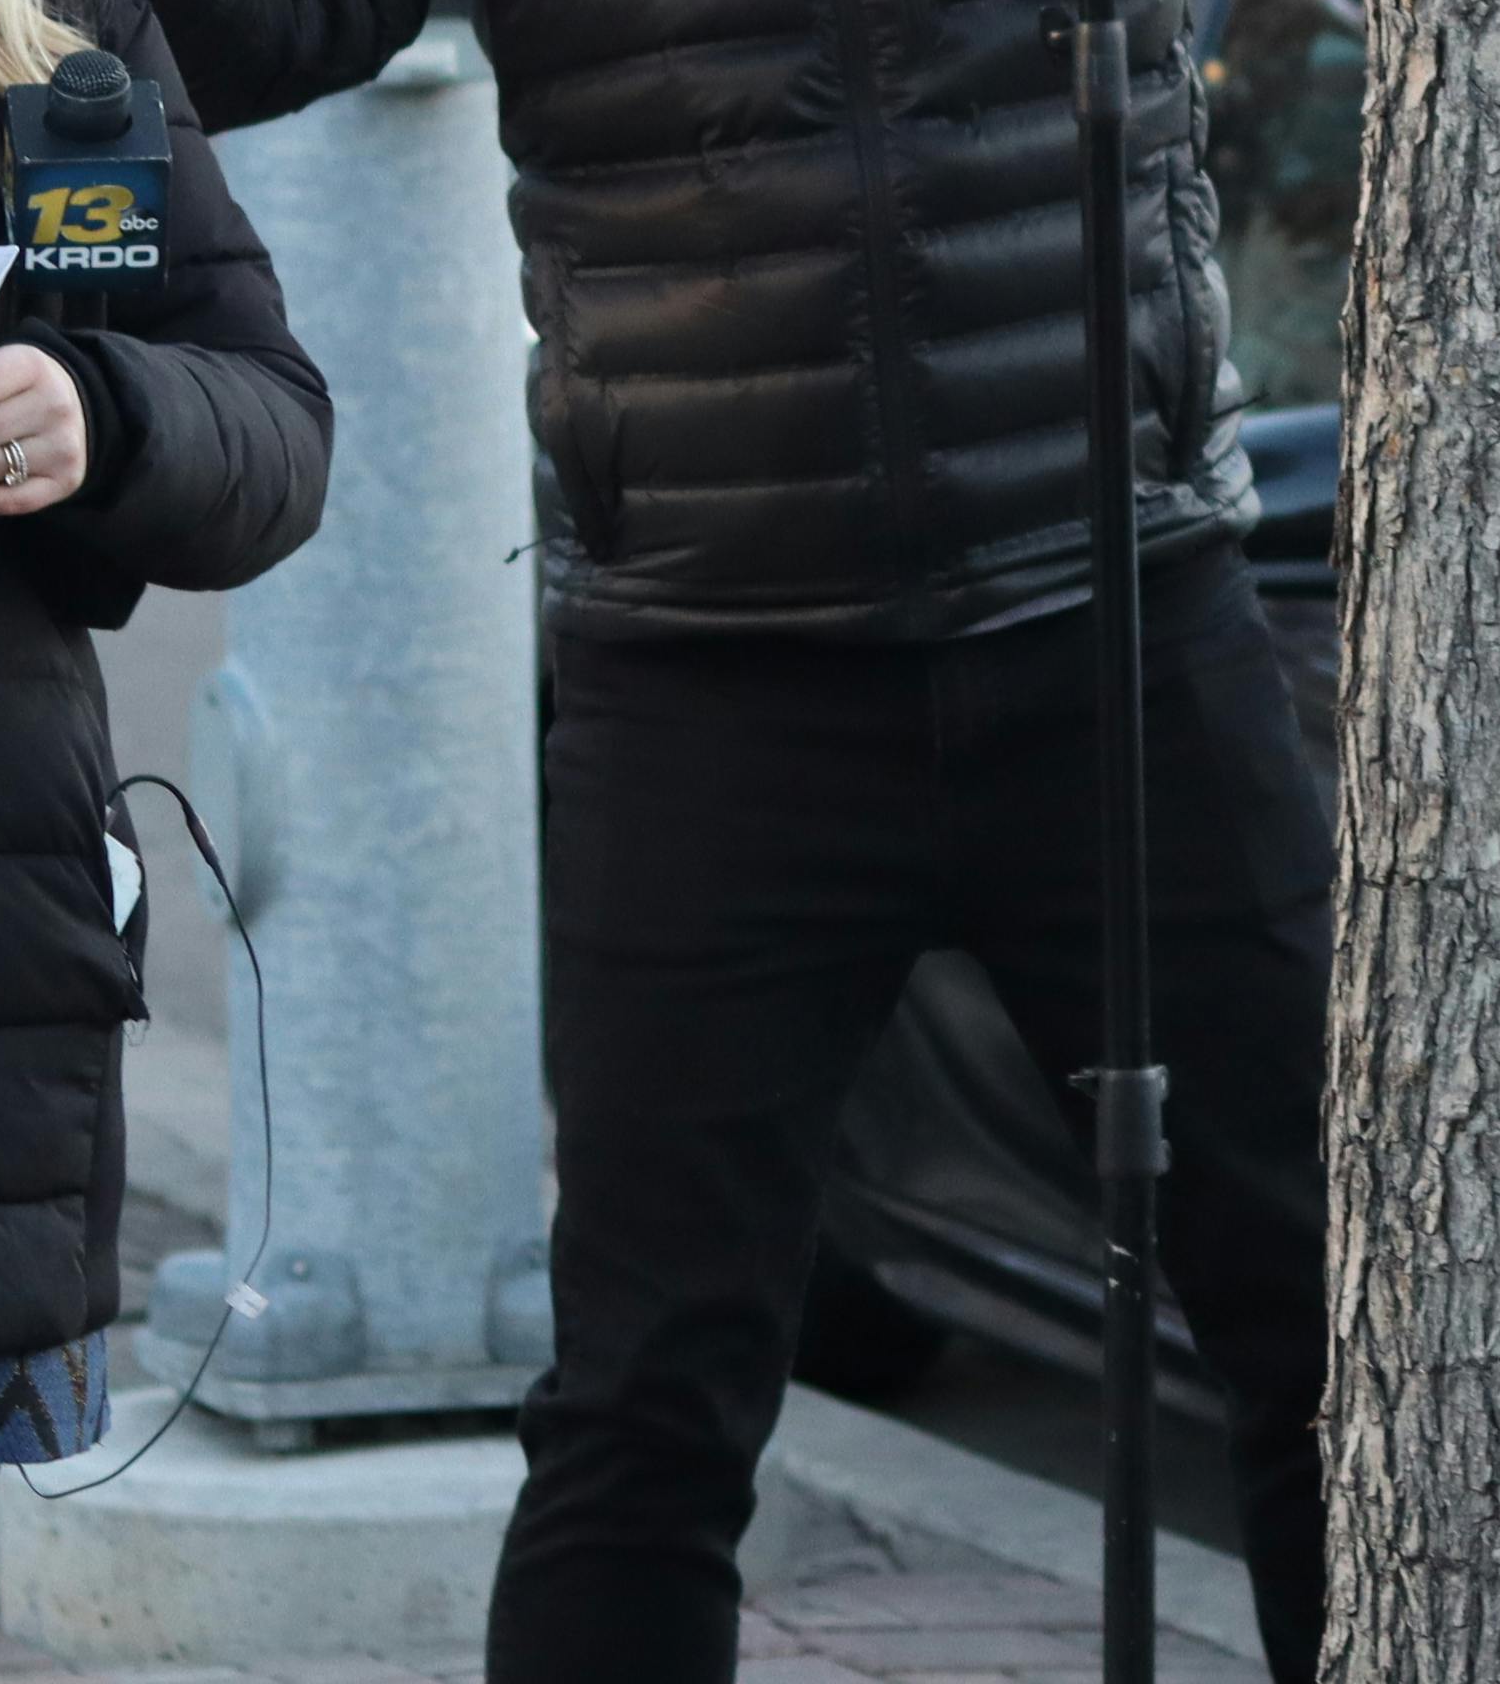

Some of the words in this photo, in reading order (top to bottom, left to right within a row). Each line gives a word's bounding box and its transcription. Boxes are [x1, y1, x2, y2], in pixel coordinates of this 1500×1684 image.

[27, 184, 135, 245] 13
[119, 214, 159, 232] abc
[24, 244, 160, 272] KRDO
